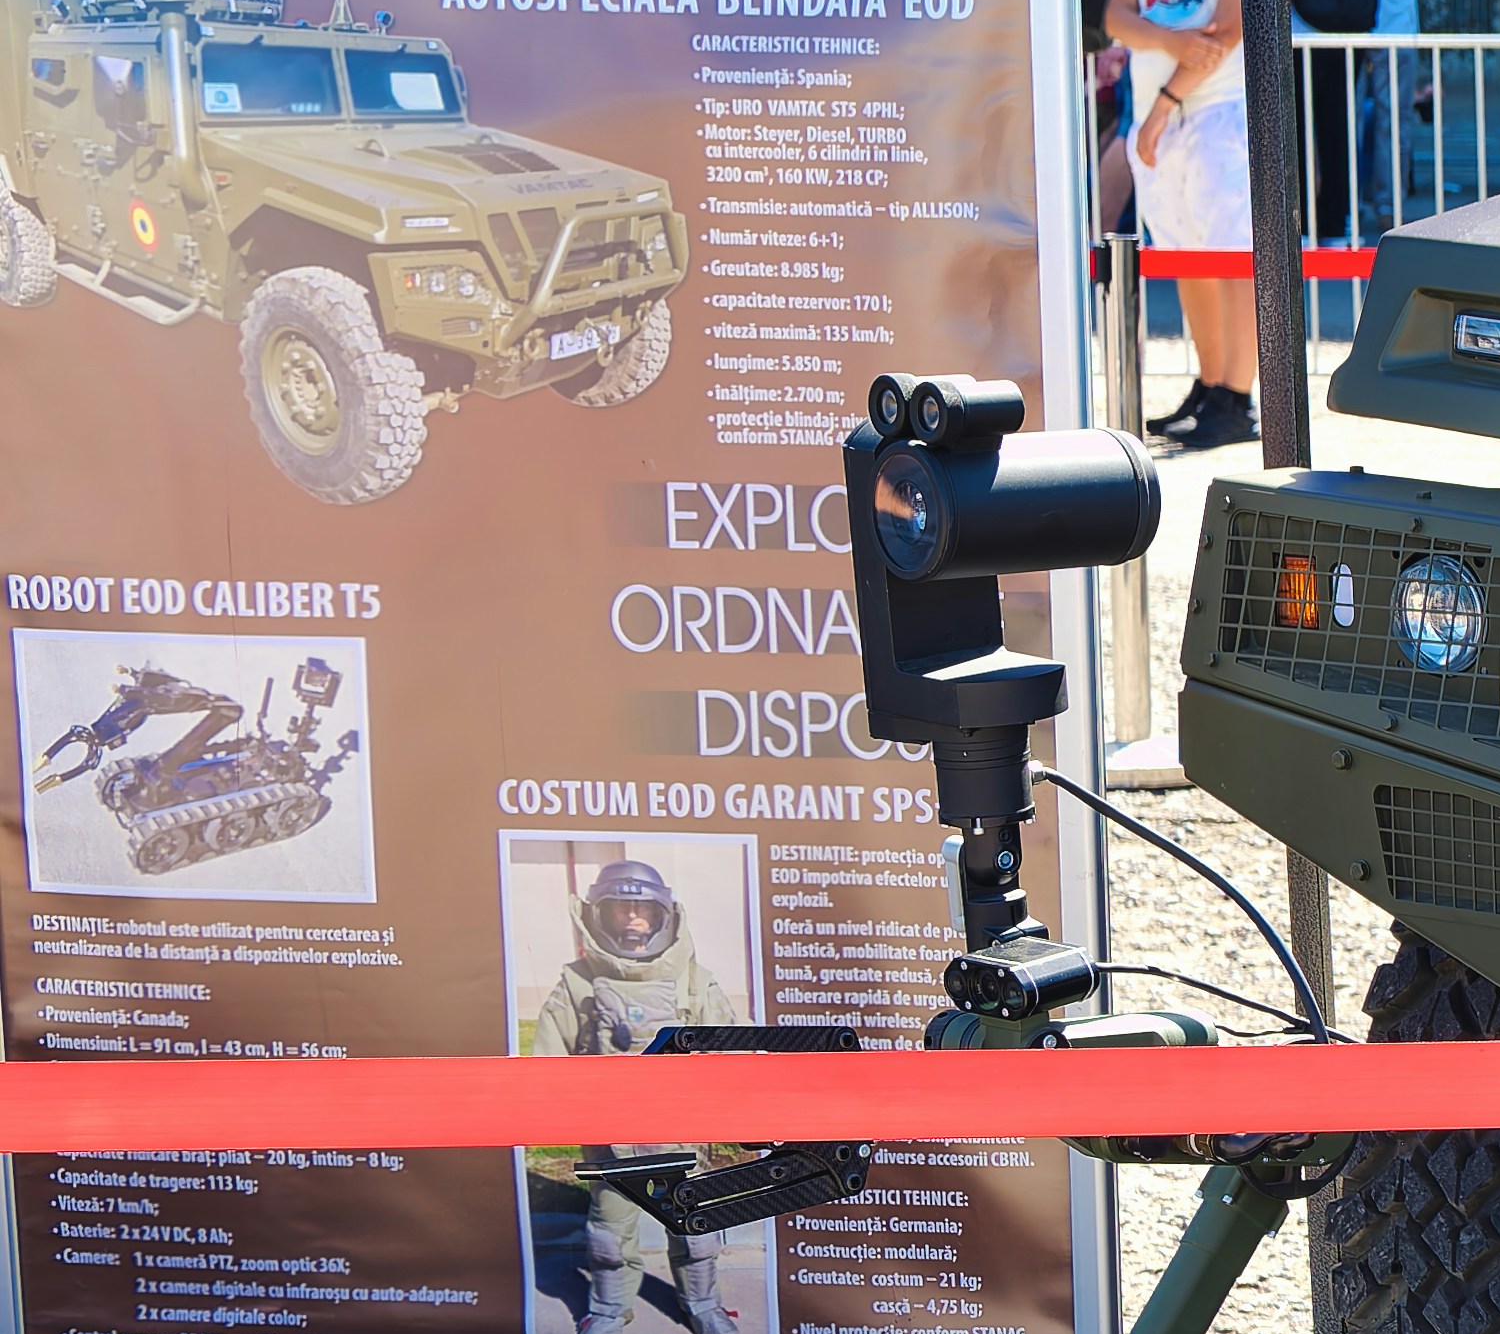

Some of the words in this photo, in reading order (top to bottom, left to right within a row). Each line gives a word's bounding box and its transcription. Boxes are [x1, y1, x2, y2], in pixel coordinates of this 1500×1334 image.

[692, 34, 810, 54] CARACTERISTICI
[812, 37, 880, 55] TEHNICE:
[797, 69, 853, 89] Spania;
[703, 98, 730, 118] Tip:
[732, 99, 762, 116] URO
[768, 100, 825, 117] VAMTAC
[831, 101, 857, 117] ST5
[863, 102, 905, 120] 4PHL;
[705, 124, 751, 141] Motor:
[753, 125, 803, 145] Steyer,
[806, 126, 855, 145] Diesel,
[858, 127, 906, 144] TURBO
[706, 146, 722, 159] cu
[724, 143, 805, 163] intercooler,
[807, 145, 817, 161] 6
[819, 144, 871, 162] cilindri
[891, 146, 928, 165] linie,
[510, 179, 594, 194] VAMTAC
[706, 166, 741, 182] 3200
[776, 168, 802, 184] 160
[805, 168, 833, 187] KW,
[836, 170, 862, 185] 218
[865, 169, 888, 189] CP;
[707, 196, 787, 215] Transmisie:
[790, 200, 872, 217] automatică
[889, 202, 909, 221] tip
[912, 202, 980, 221] ALLISON;
[710, 228, 758, 246] Număr
[760, 230, 806, 247] viteze:
[808, 232, 844, 250] 6+1;
[710, 259, 778, 278] Greutate:
[780, 262, 819, 279] 8.985
[821, 262, 844, 283] kg;
[666, 481, 852, 553] EXPLO
[8, 574, 114, 612] ROBOT
[122, 578, 186, 615] EOD
[192, 580, 335, 618] CALIBER
[340, 583, 381, 619] T5
[611, 584, 862, 655] ORDNA
[498, 778, 639, 817] COSTUM
[648, 781, 717, 818] EOD
[724, 783, 864, 821] GARANT
[771, 868, 800, 884] EOD
[802, 870, 872, 887] împotriva
[875, 870, 937, 888] efectelor
[772, 893, 834, 910] explozii.
[116, 919, 166, 936] robotul
[168, 924, 199, 937] este
[202, 922, 252, 939] utilizat
[255, 925, 304, 943] pentru
[305, 928, 380, 943] cercetarea
[773, 918, 813, 935] Oferă
[816, 923, 835, 935] un
[838, 920, 873, 936] nivel
[875, 920, 921, 938] ridicat
[922, 923, 940, 938] de
[34, 939, 122, 957] neutralizarea
[124, 942, 142, 958] de
[144, 943, 159, 959] la
[221, 949, 231, 961] a
[233, 946, 329, 965] dispozitivelor
[331, 949, 403, 968] explozive.
[774, 942, 840, 960] balistică,
[842, 944, 916, 961] mobilitate
[775, 964, 818, 983] bună,
[819, 968, 883, 985] greutate
[885, 967, 937, 986] redusă,
[36, 977, 143, 998] CARACTERISTICI
[145, 982, 211, 1001] TEHNICE:
[133, 1010, 190, 1029] Canada;
[57, 1167, 126, 1188] Capacitate
[129, 1171, 146, 1187] de
[149, 1173, 206, 1193] tragere:
[208, 1175, 233, 1191] 113
[236, 1175, 258, 1194] kg;
[58, 1195, 105, 1212] Viteză:
[106, 1198, 115, 1212] 7
[117, 1198, 160, 1217] km/h;
[889, 1218, 963, 1236] Germania;
[884, 1244, 957, 1263] modulară;
